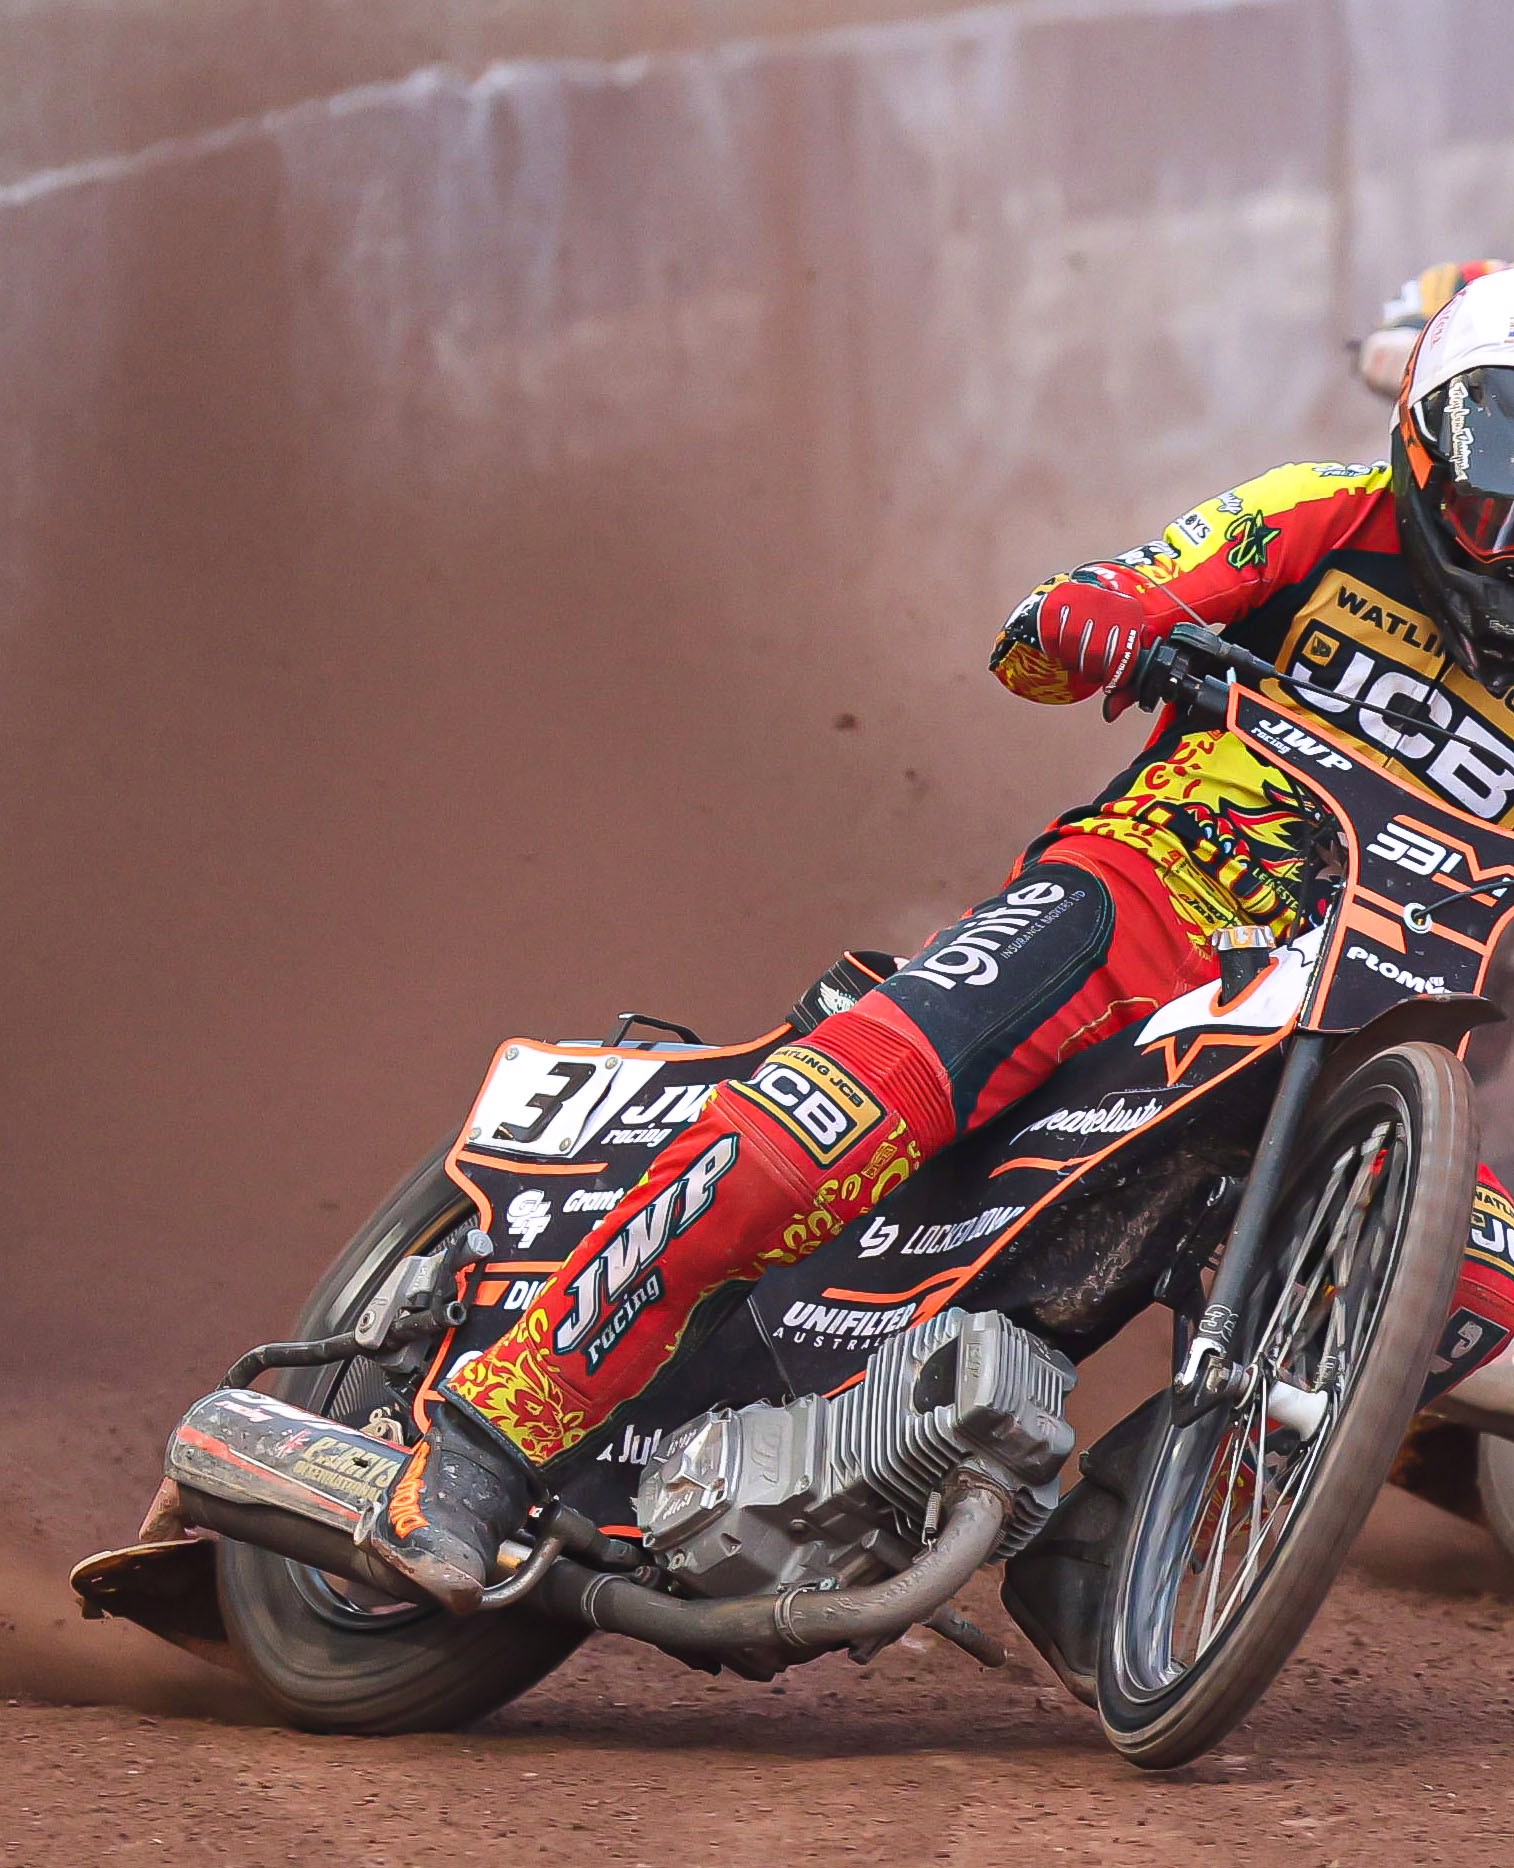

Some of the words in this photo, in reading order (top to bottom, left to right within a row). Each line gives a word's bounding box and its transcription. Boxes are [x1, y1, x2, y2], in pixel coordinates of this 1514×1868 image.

[1336, 585, 1446, 658] WATLI
[1251, 726, 1290, 755] racing
[1259, 717, 1354, 771] JWP
[906, 881, 1065, 989] ignite
[1000, 922, 1046, 960] INSURANCE
[1040, 899, 1074, 924] BROKERS
[493, 1061, 597, 1143] 3
[620, 1084, 718, 1125] JW
[830, 1076, 865, 1108] JCB
[600, 1123, 674, 1150] racing
[563, 1187, 625, 1214] Grant
[555, 1133, 740, 1357] JWP
[585, 1271, 662, 1373] racing
[772, 1326, 882, 1351] AUSTRAL
[783, 1300, 917, 1337] UNIFILTER
